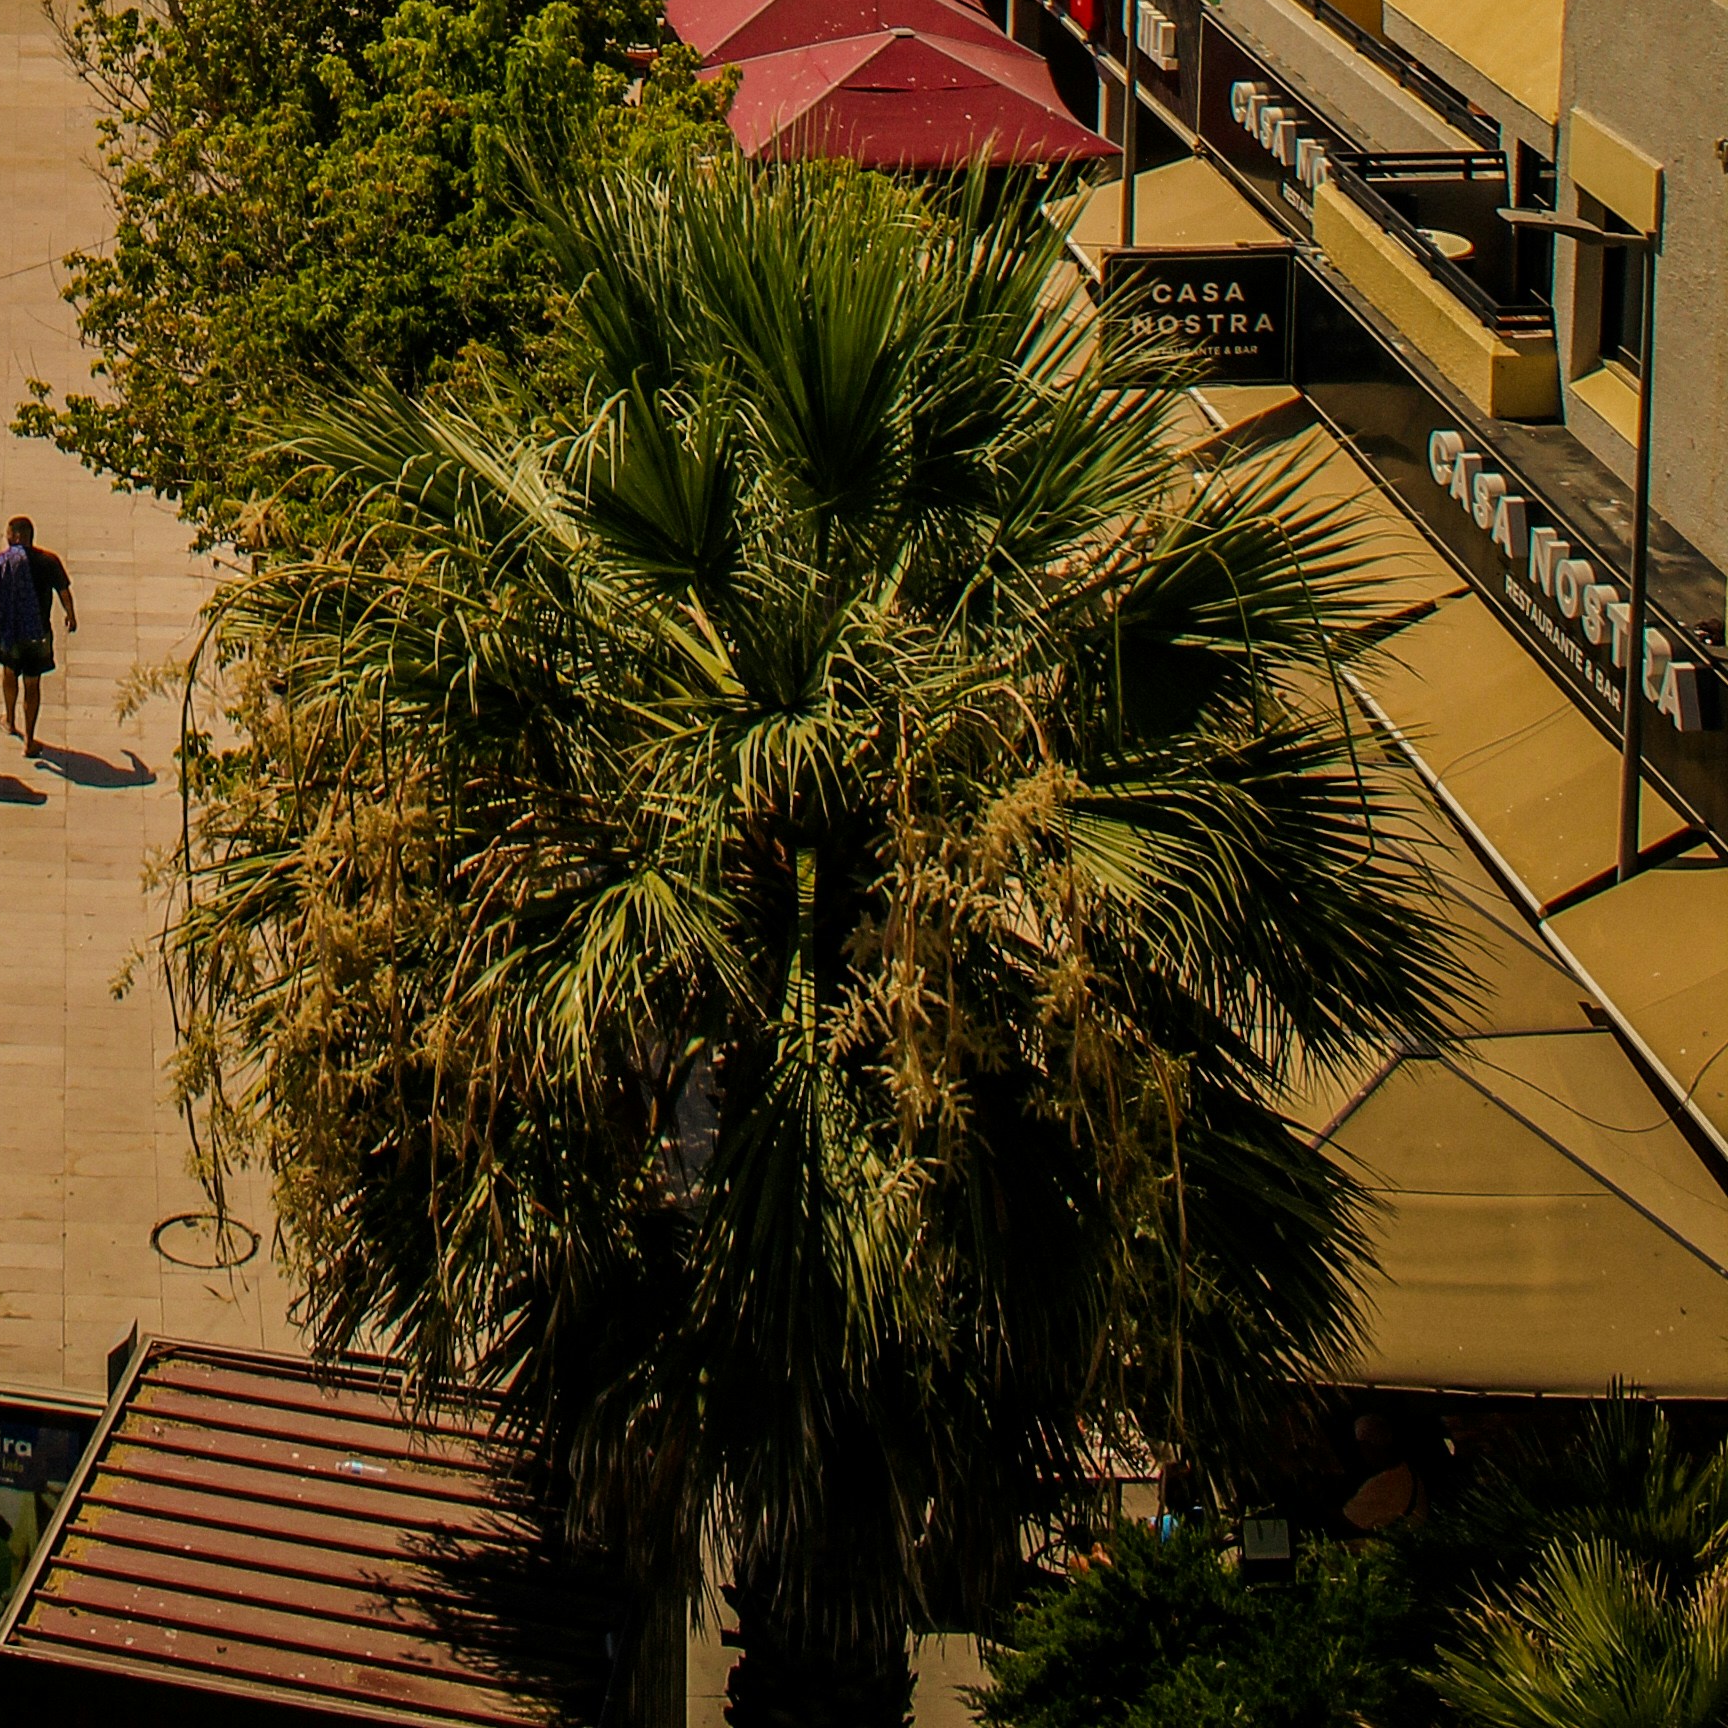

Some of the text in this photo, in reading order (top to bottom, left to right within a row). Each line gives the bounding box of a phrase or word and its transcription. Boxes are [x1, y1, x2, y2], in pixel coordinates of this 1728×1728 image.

[1230, 80, 1298, 167] CASA
[1152, 282, 1245, 305] CASA
[1130, 312, 1275, 336] NOSTRA
[1223, 345, 1232, 355] &
[1234, 345, 1259, 355] BAR
[1428, 430, 1702, 734] CASA NOSTRA
[1504, 572, 1584, 674] RESTAURANTE
[1595, 671, 1622, 713] BAR
